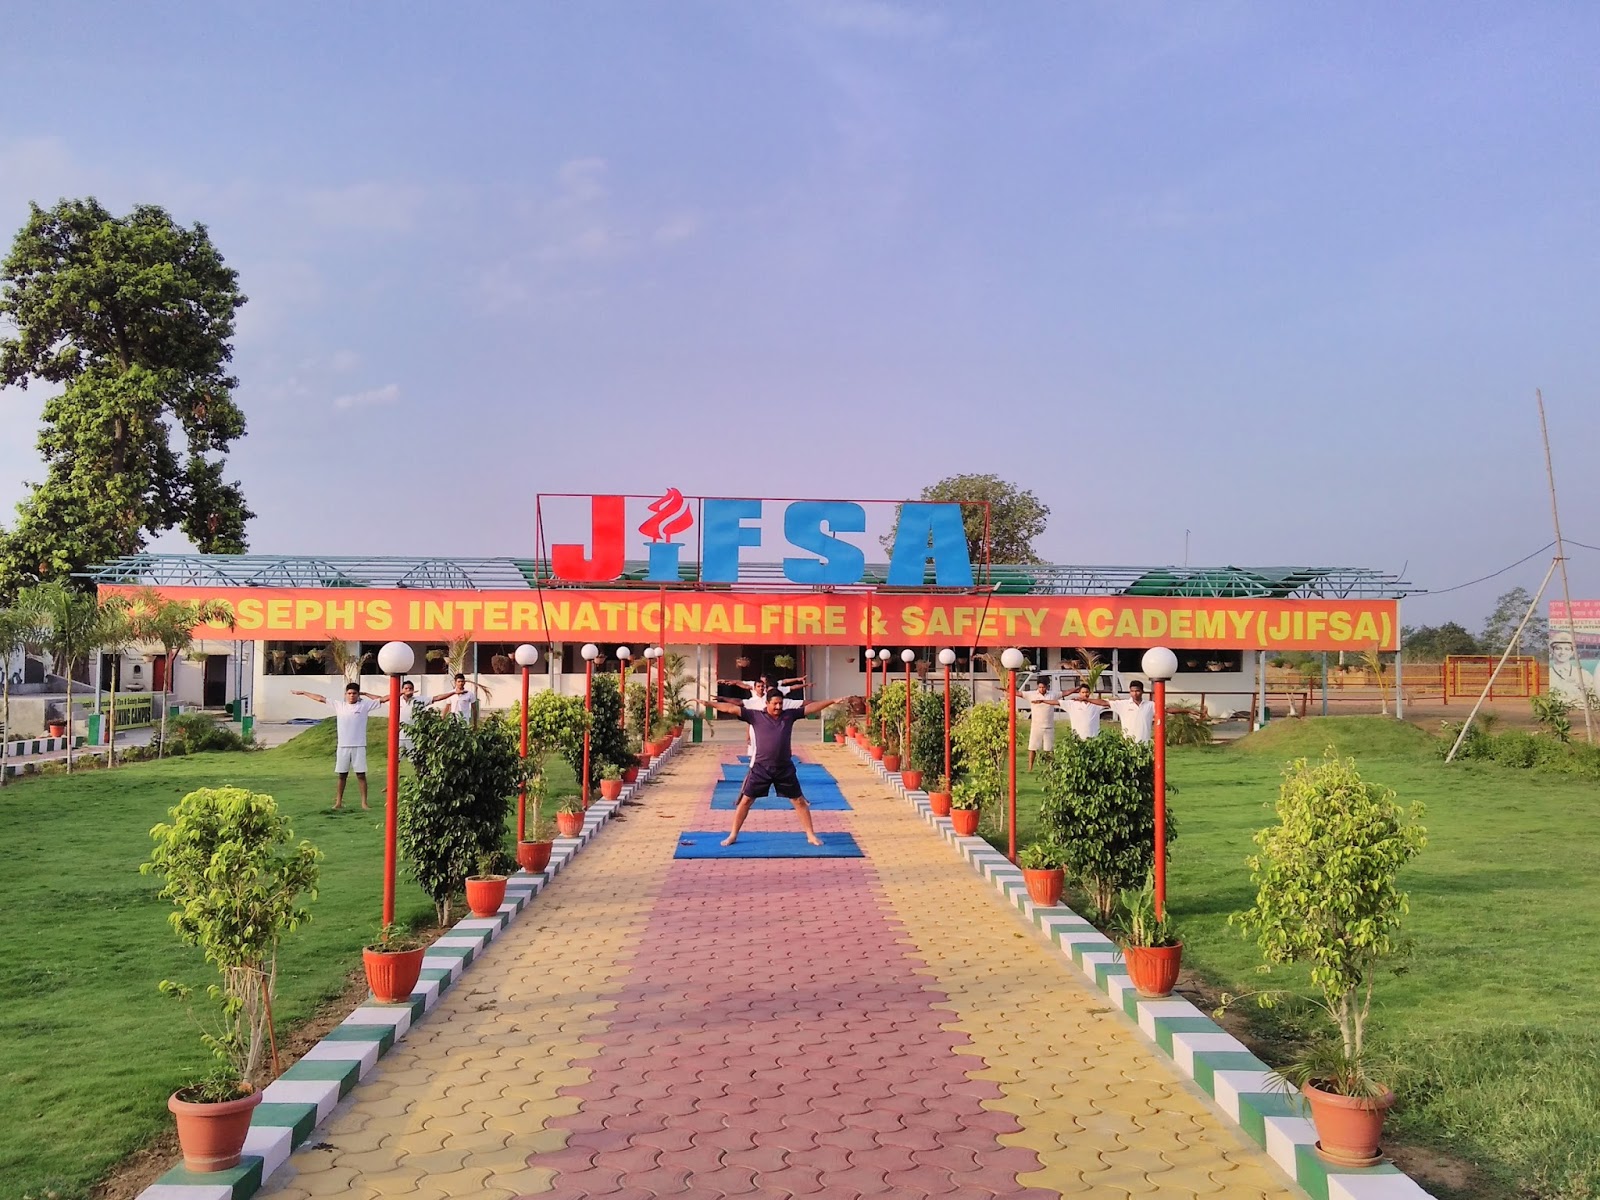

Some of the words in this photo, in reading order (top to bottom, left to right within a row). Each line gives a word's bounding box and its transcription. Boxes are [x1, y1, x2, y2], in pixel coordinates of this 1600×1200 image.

[409, 601, 756, 633] INTERNATIONAL
[761, 605, 846, 634] FIRE
[859, 607, 888, 636] &
[901, 607, 1048, 636] SAFETY
